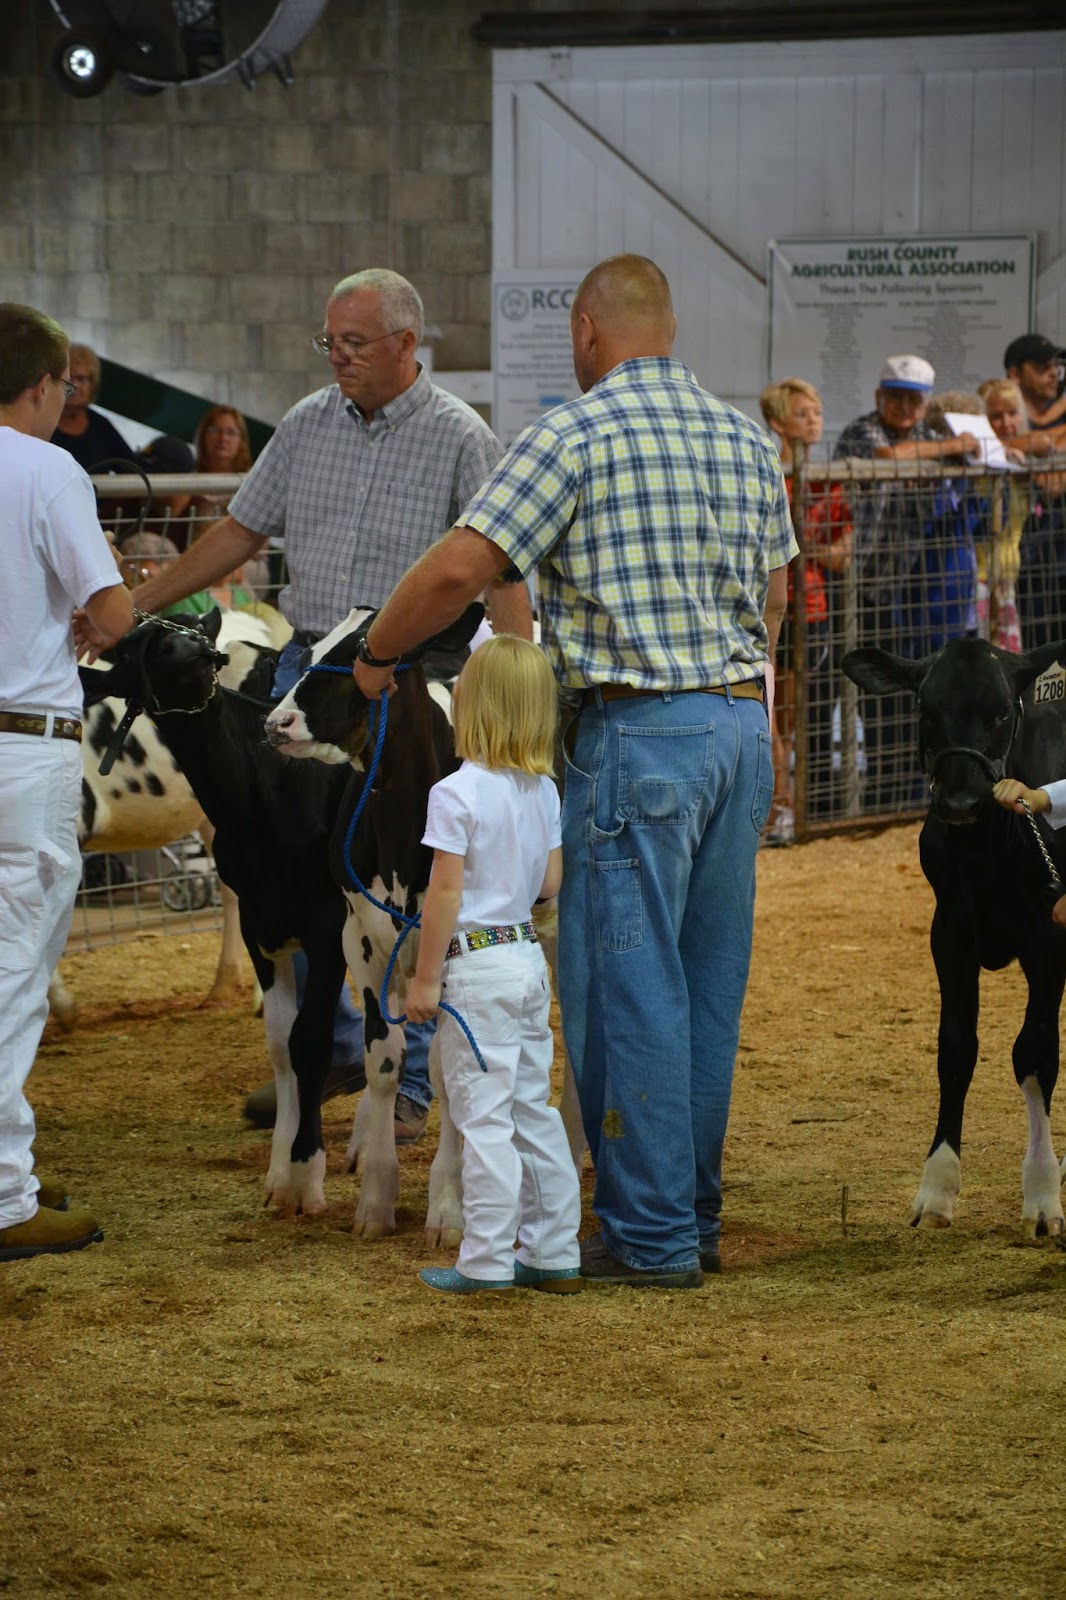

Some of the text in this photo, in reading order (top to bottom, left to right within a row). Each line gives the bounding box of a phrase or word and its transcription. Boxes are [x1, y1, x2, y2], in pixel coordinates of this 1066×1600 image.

[847, 245, 959, 262] RUSH COUNTY
[791, 261, 1016, 278] AGRICULTURAL ASSOCIATION
[819, 282, 984, 296] Thanks The Following Sponsors
[1036, 680, 1064, 703] 1208
